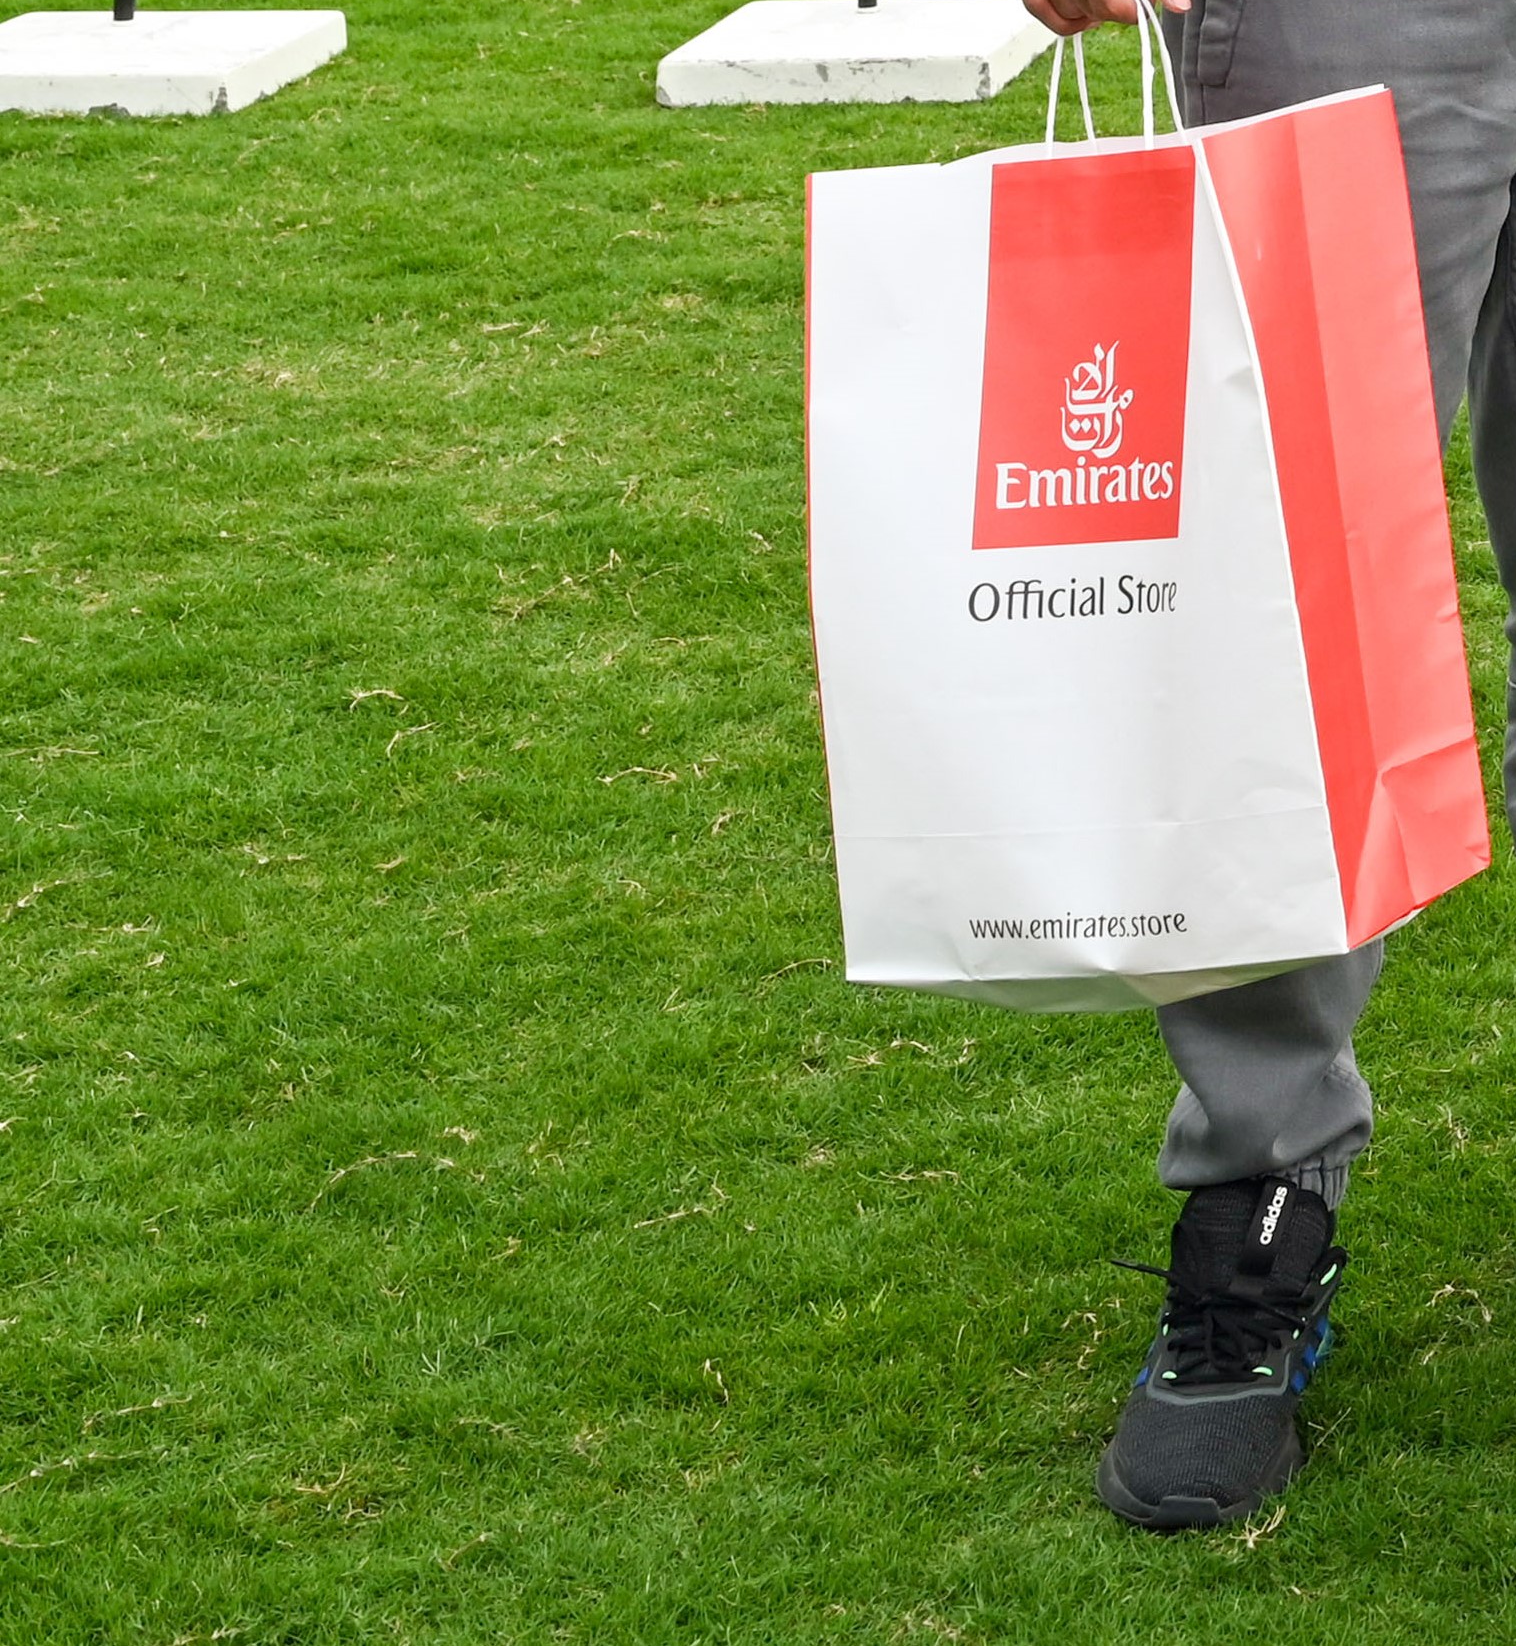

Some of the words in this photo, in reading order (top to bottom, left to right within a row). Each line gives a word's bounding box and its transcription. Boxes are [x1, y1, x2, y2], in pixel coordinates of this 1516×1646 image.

[994, 455, 1175, 510] Emirates
[968, 575, 1105, 622] Official
[1117, 574, 1178, 615] Store
[968, 911, 1188, 940] www.emirates.store
[1259, 1185, 1288, 1245] adidas
